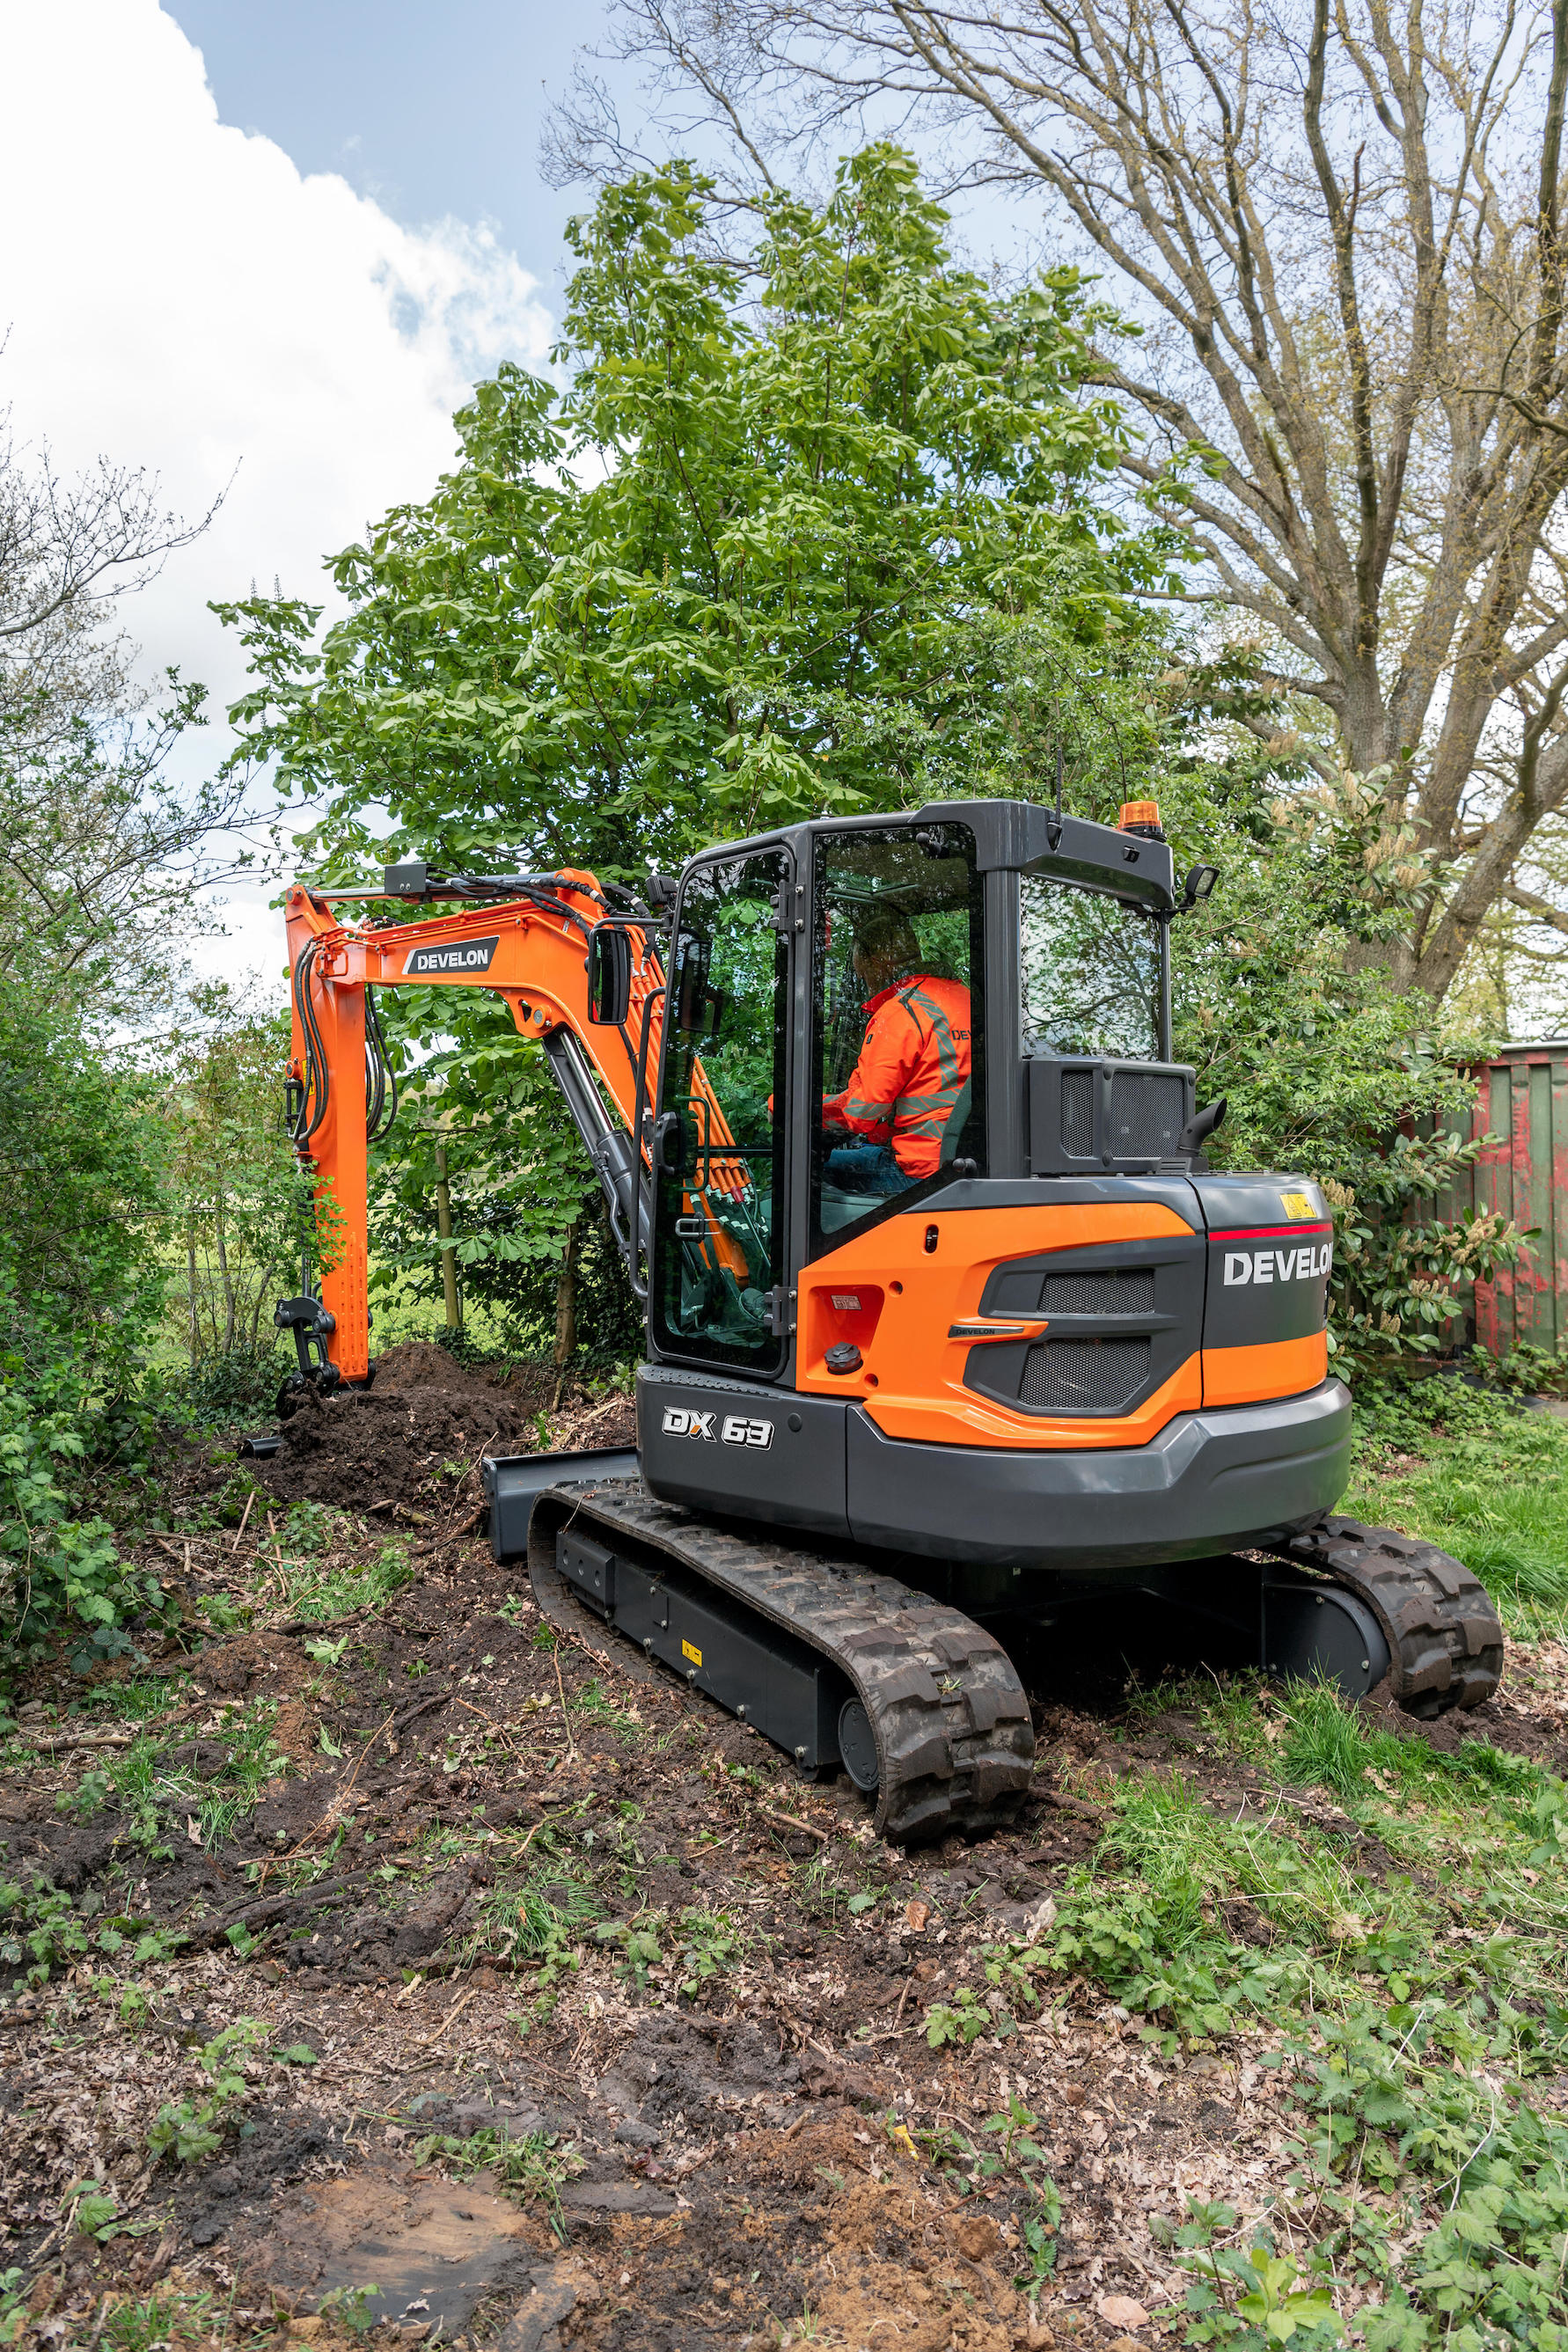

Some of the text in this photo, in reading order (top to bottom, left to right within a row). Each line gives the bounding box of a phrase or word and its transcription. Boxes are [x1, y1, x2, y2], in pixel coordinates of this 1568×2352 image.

[417, 949, 488, 970] DEVELON
[662, 1406, 774, 1450] DX 63
